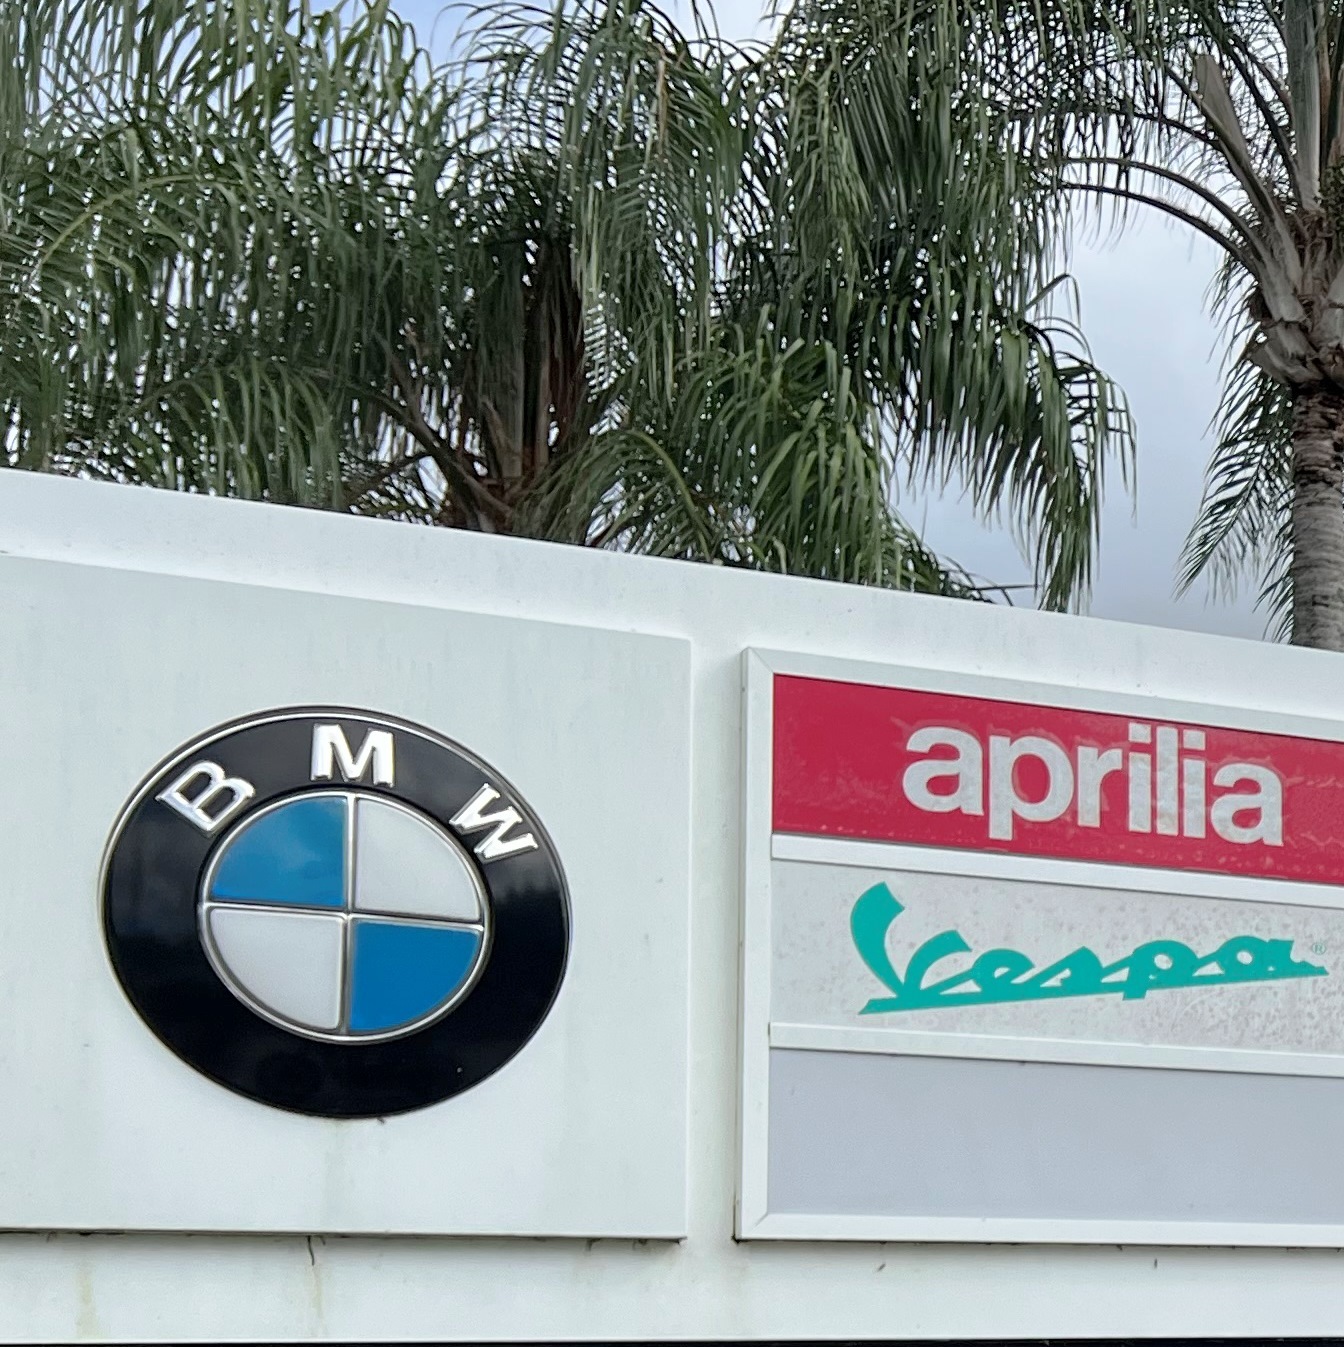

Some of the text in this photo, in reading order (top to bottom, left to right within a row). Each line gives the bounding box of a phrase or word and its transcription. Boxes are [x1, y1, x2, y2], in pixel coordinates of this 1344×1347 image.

[155, 724, 538, 864] BMW
[901, 721, 1284, 847] aprilia
[850, 881, 1329, 1015] Vespa
